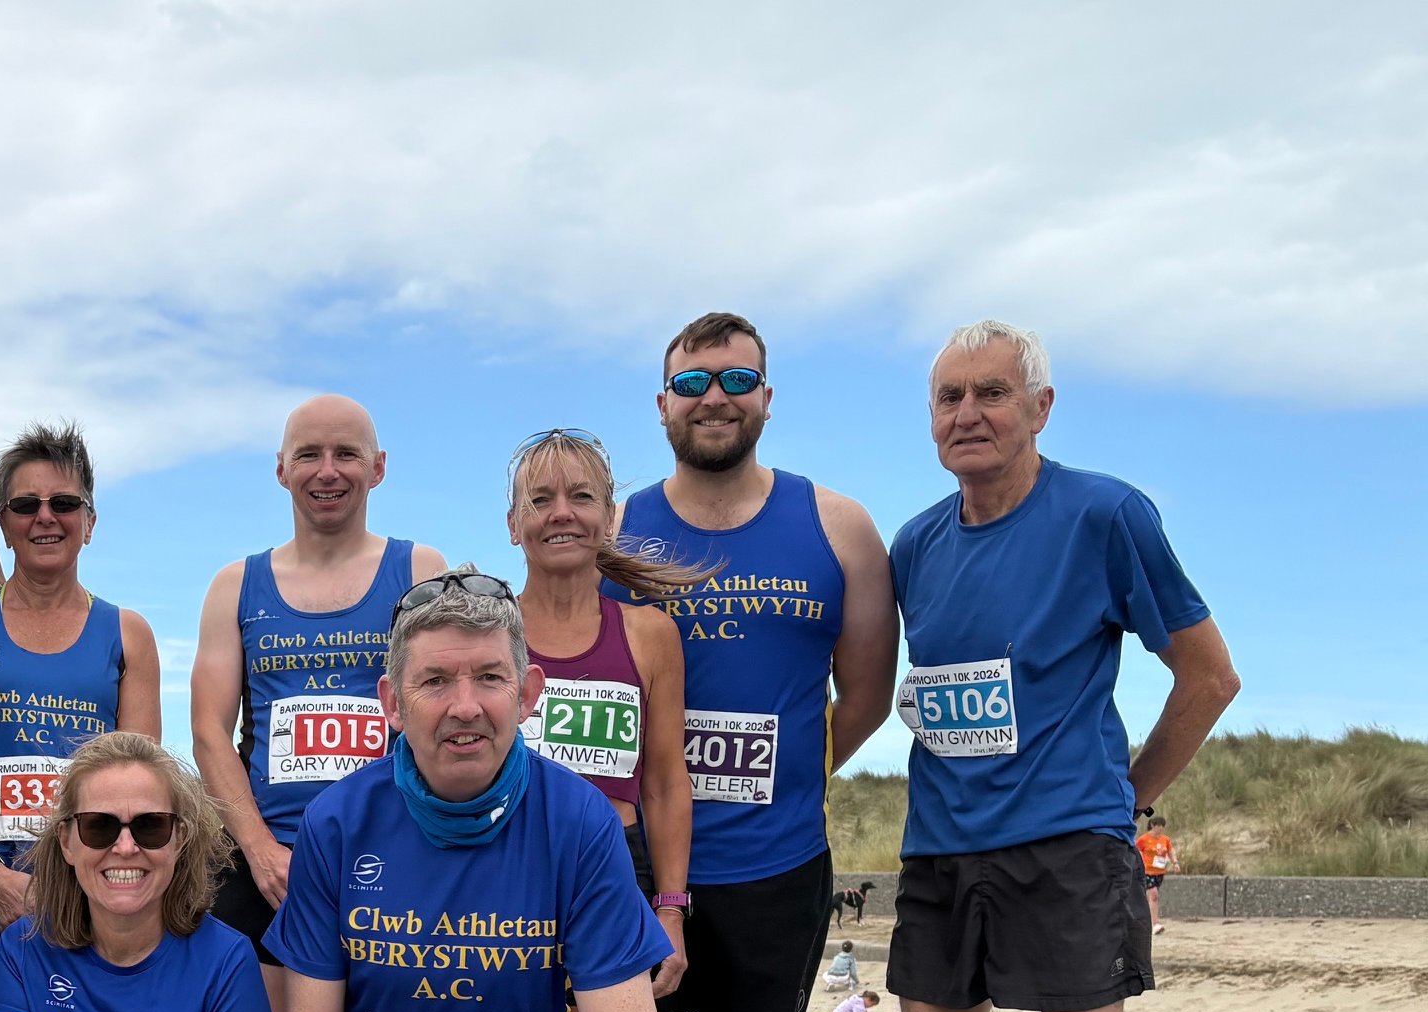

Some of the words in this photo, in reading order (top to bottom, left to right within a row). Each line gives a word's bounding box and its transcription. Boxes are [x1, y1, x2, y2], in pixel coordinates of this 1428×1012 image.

[702, 574, 808, 593] Athletau
[687, 620, 745, 640] A.C.
[259, 633, 306, 650] Clwb
[312, 630, 390, 647] Athletau
[304, 674, 346, 690] A.C.
[953, 672, 970, 682] 10K
[973, 669, 1000, 680] 2026
[26, 692, 98, 713] Athletau
[541, 687, 590, 698] RMOUTH
[596, 690, 614, 699] 10K
[617, 691, 634, 703] 2026
[923, 686, 1008, 722] 5106
[280, 703, 333, 714] BARMOUTH
[337, 703, 354, 712] 10K
[357, 705, 380, 714] 2026
[550, 703, 636, 743] 2113
[724, 721, 742, 730] 10K
[14, 727, 54, 745] A.C.
[303, 718, 384, 750] 1015
[948, 728, 1013, 745] GWYNN
[684, 735, 771, 770] 4012
[41, 763, 57, 773] 10K
[280, 757, 329, 772] GARY
[705, 776, 759, 793] ELERI
[348, 906, 422, 935] Clwb
[431, 912, 557, 939] Athletau
[412, 977, 483, 1002] A.C.
